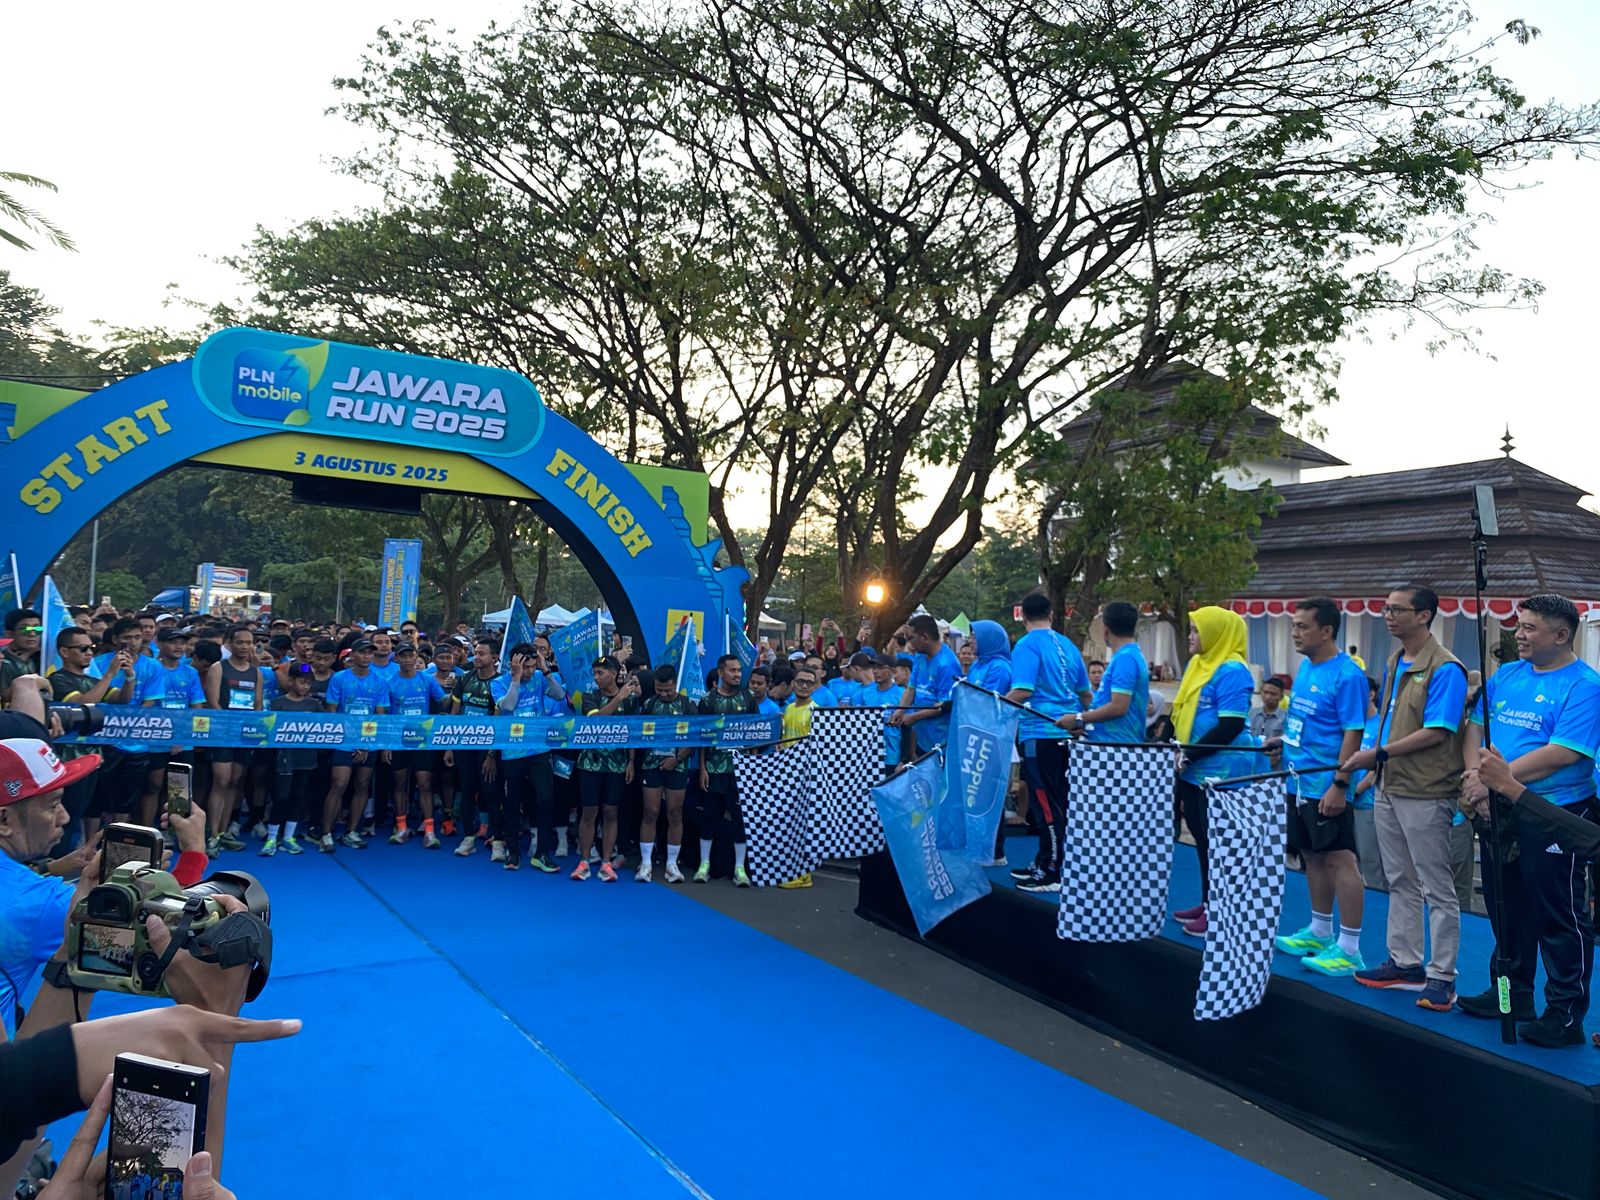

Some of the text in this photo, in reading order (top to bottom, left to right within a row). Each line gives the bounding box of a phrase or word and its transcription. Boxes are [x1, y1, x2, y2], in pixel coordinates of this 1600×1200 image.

[238, 366, 275, 384] PLN
[237, 383, 302, 404] mobile
[331, 366, 507, 415] JAWARA
[326, 394, 507, 441] RUN 2025
[20, 399, 173, 514] START
[294, 451, 449, 483] 3 AGUSTUS 2025
[544, 448, 654, 559] FINISH
[573, 625, 599, 642] JAWAR
[1500, 708, 1543, 722] JAWARA
[277, 721, 344, 734] JAWARA
[434, 724, 495, 736] JAWARA
[575, 723, 629, 735] JAWARA
[725, 721, 772, 731] JAWARA
[131, 729, 173, 739] 2025
[274, 733, 344, 744] RUN 2025
[432, 736, 494, 745] RUN 2025
[573, 735, 629, 744] RUN 2025
[723, 731, 772, 740] RUN 2025
